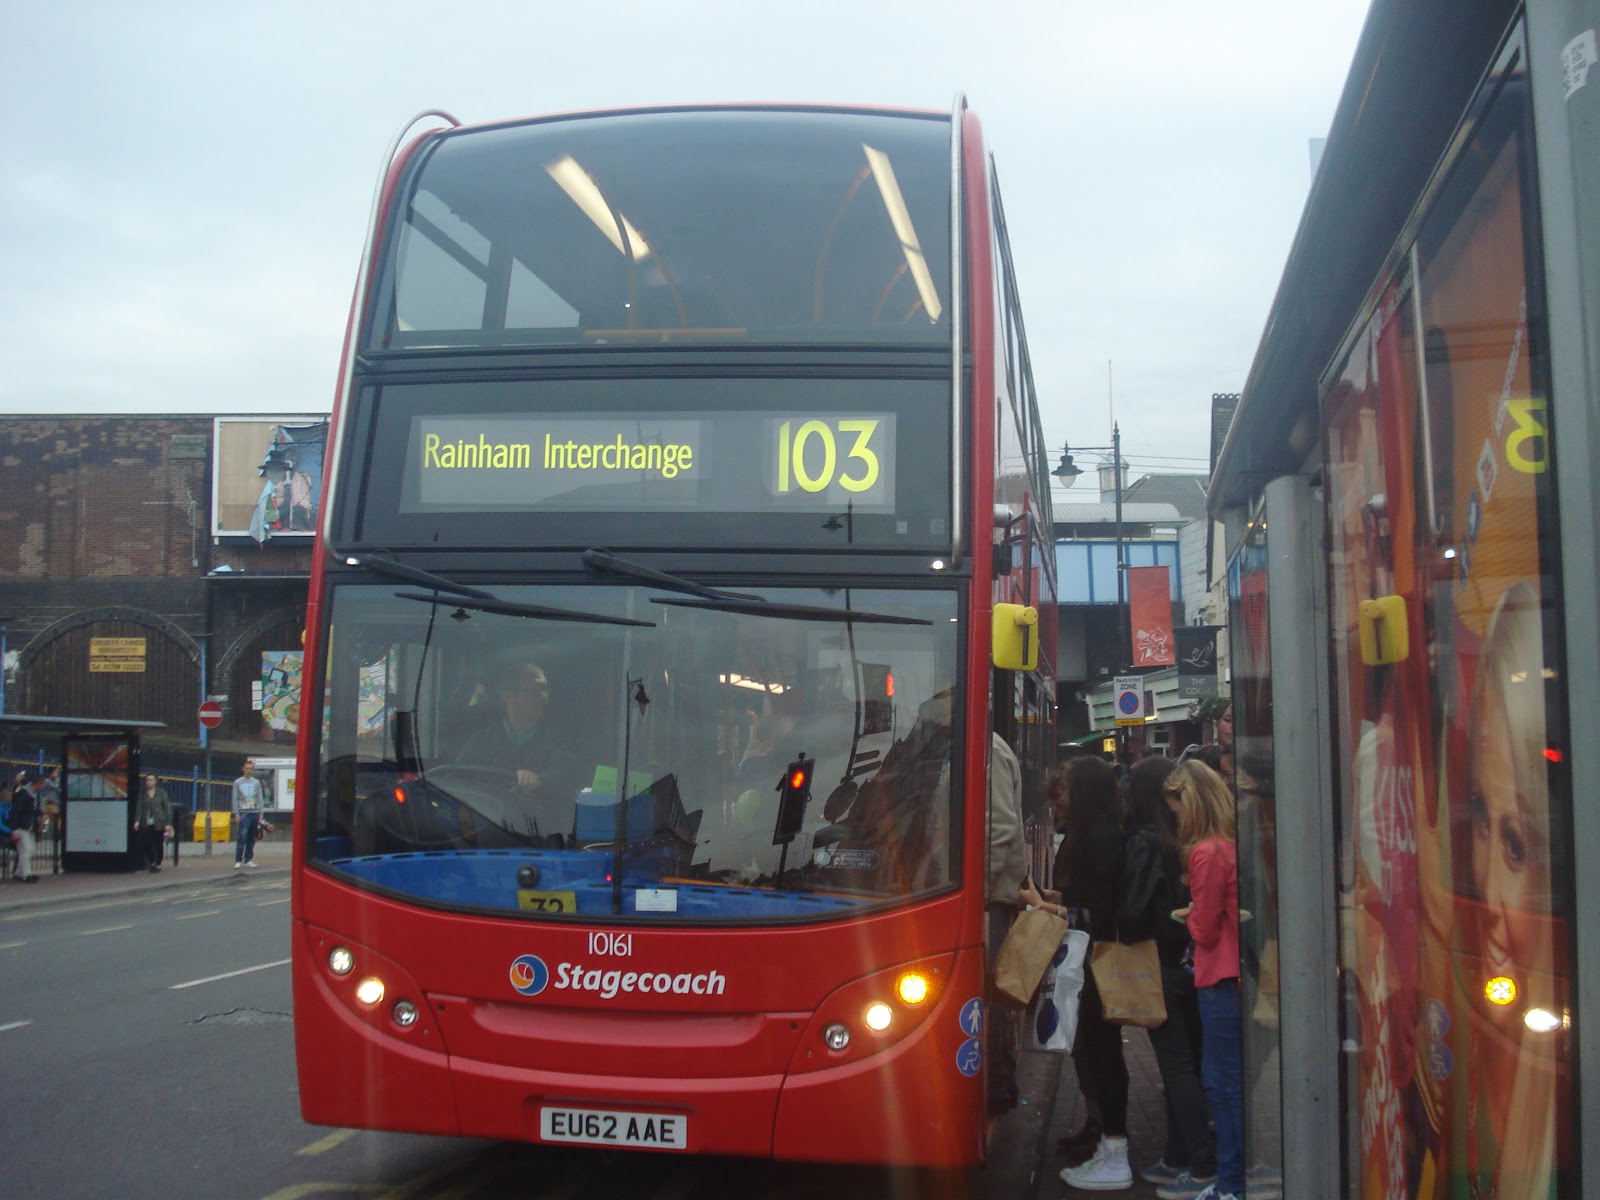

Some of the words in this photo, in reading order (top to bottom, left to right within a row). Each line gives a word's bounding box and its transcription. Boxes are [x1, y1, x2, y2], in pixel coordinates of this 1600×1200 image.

[424, 433, 531, 468] Rainham
[544, 433, 693, 478] Interchange
[778, 419, 880, 493] 103
[588, 932, 633, 956] 10161
[554, 962, 726, 999] Stagecoach
[551, 1112, 618, 1140] EU62
[625, 1117, 676, 1143] AAE
